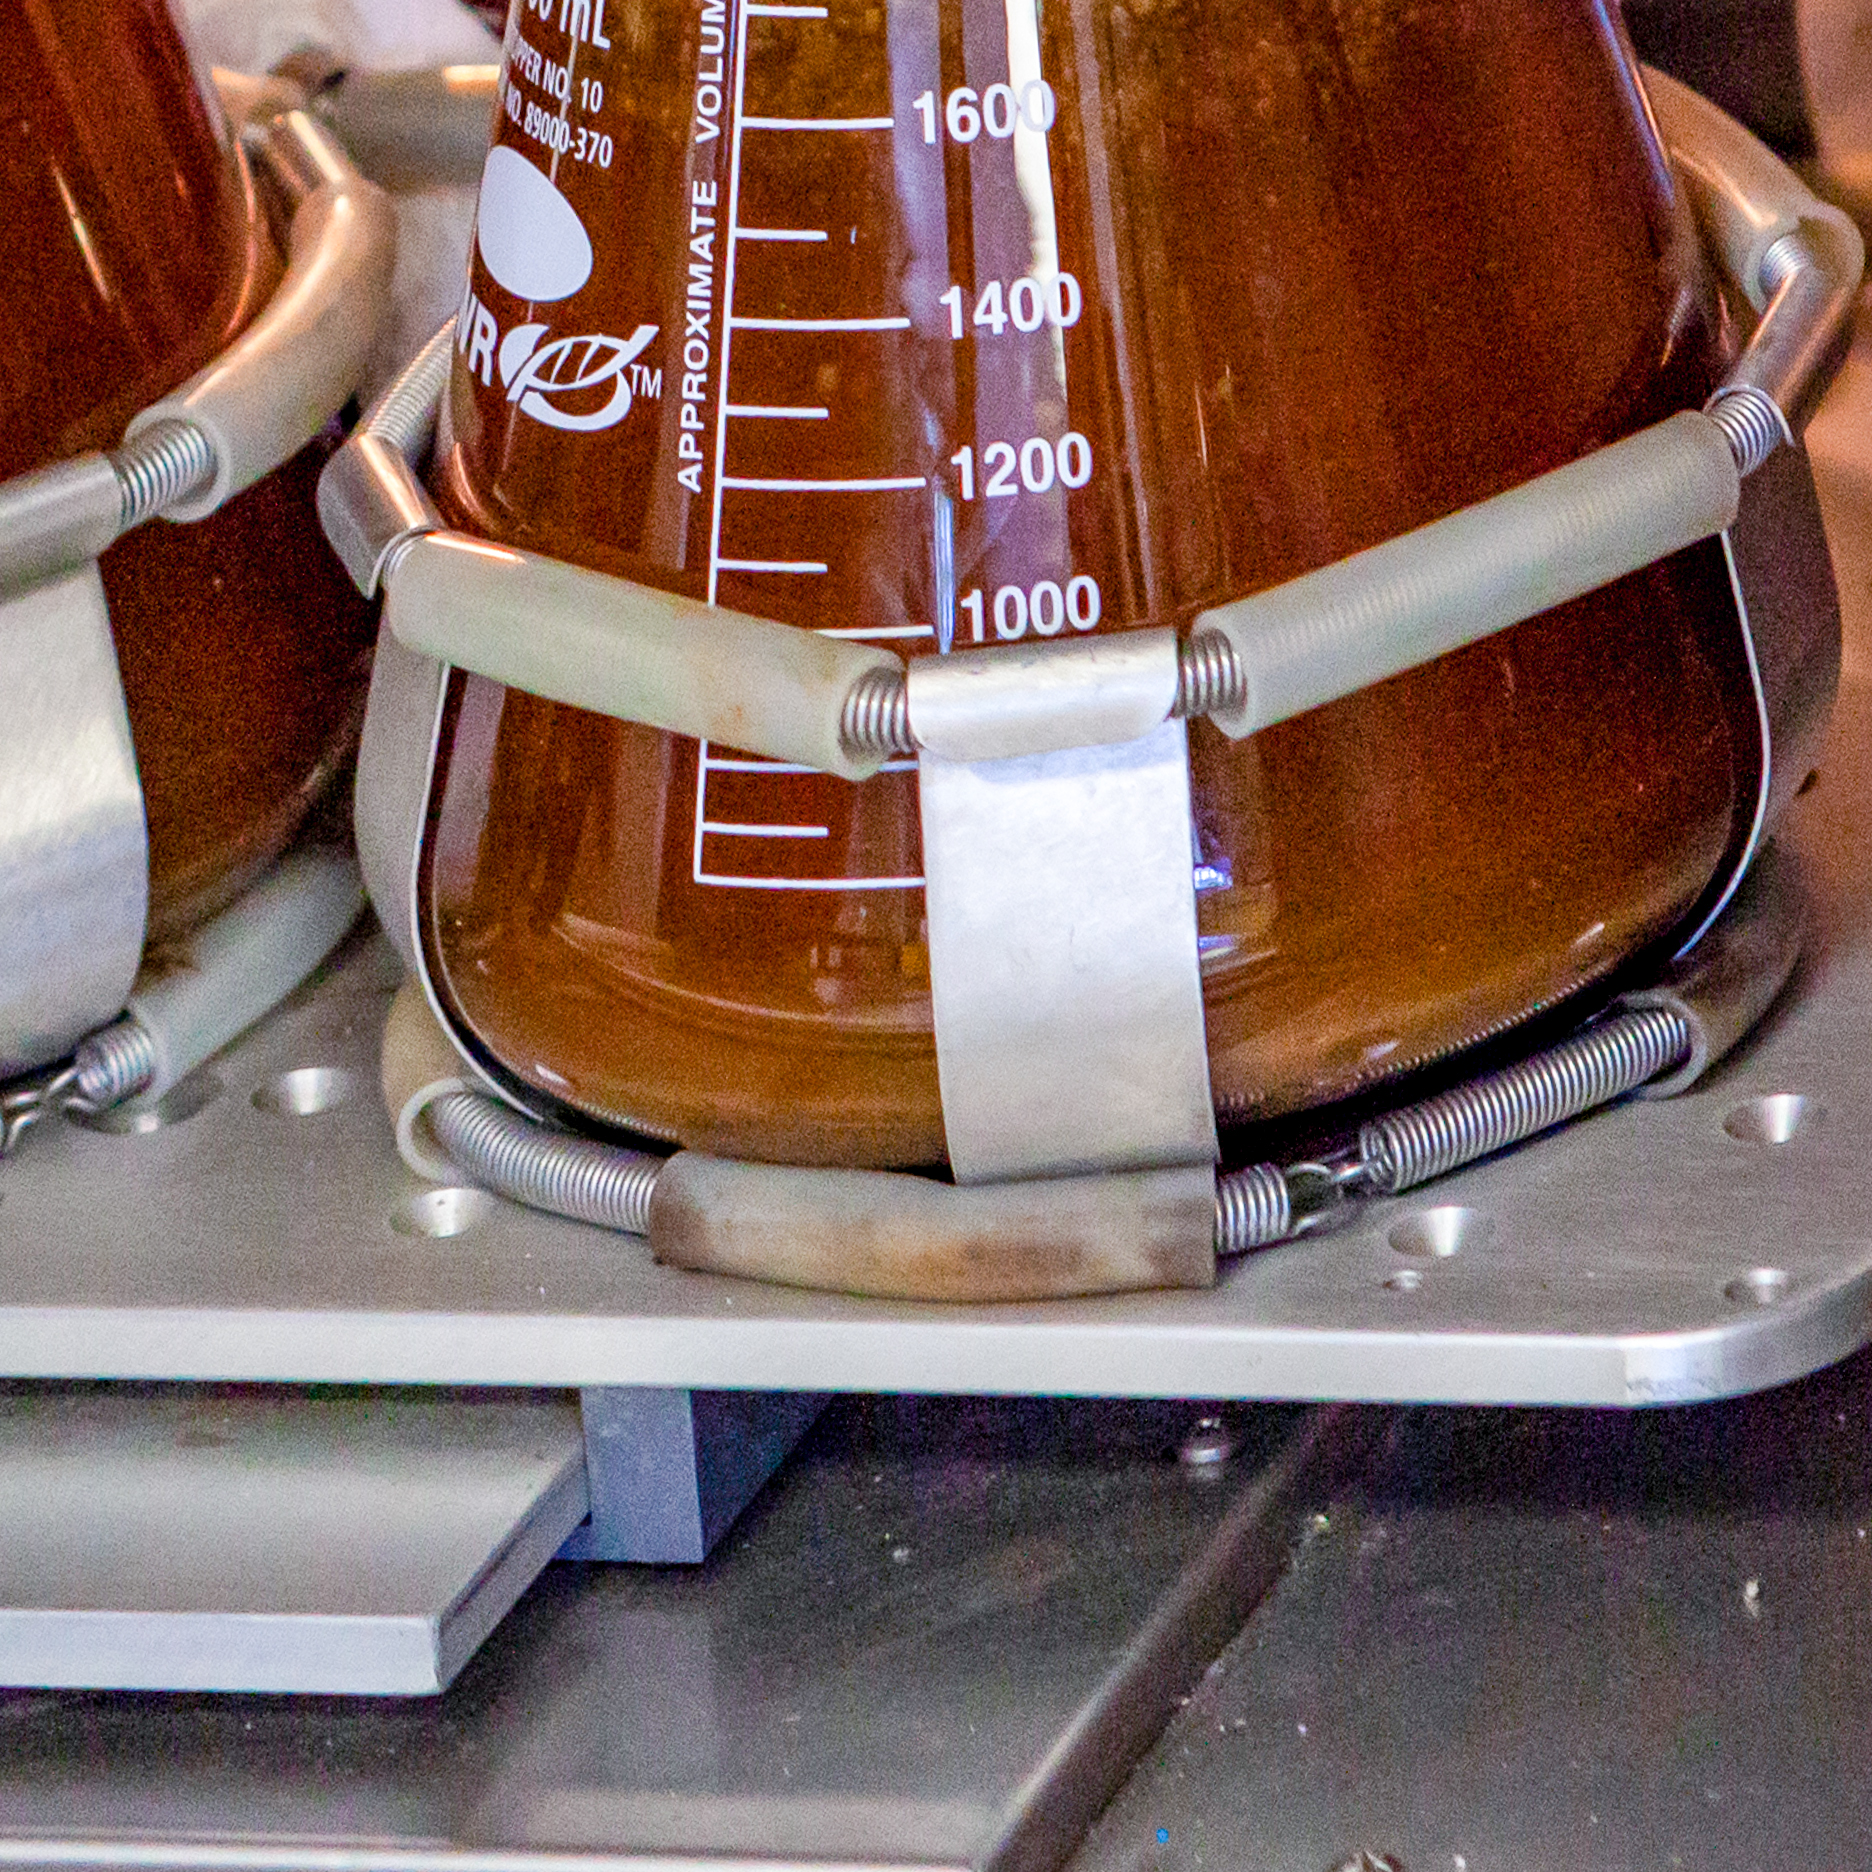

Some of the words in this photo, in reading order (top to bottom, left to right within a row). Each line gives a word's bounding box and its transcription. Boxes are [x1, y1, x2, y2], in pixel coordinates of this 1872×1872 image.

[542, 58, 572, 104] NO.
[581, 76, 604, 114] 10
[912, 78, 1055, 145] 1600
[523, 100, 613, 168] 89000-370
[677, 180, 717, 493] APPROXIMATE
[939, 270, 1082, 340] 1400
[950, 431, 1092, 500] 1200
[960, 575, 1101, 643] 1000
